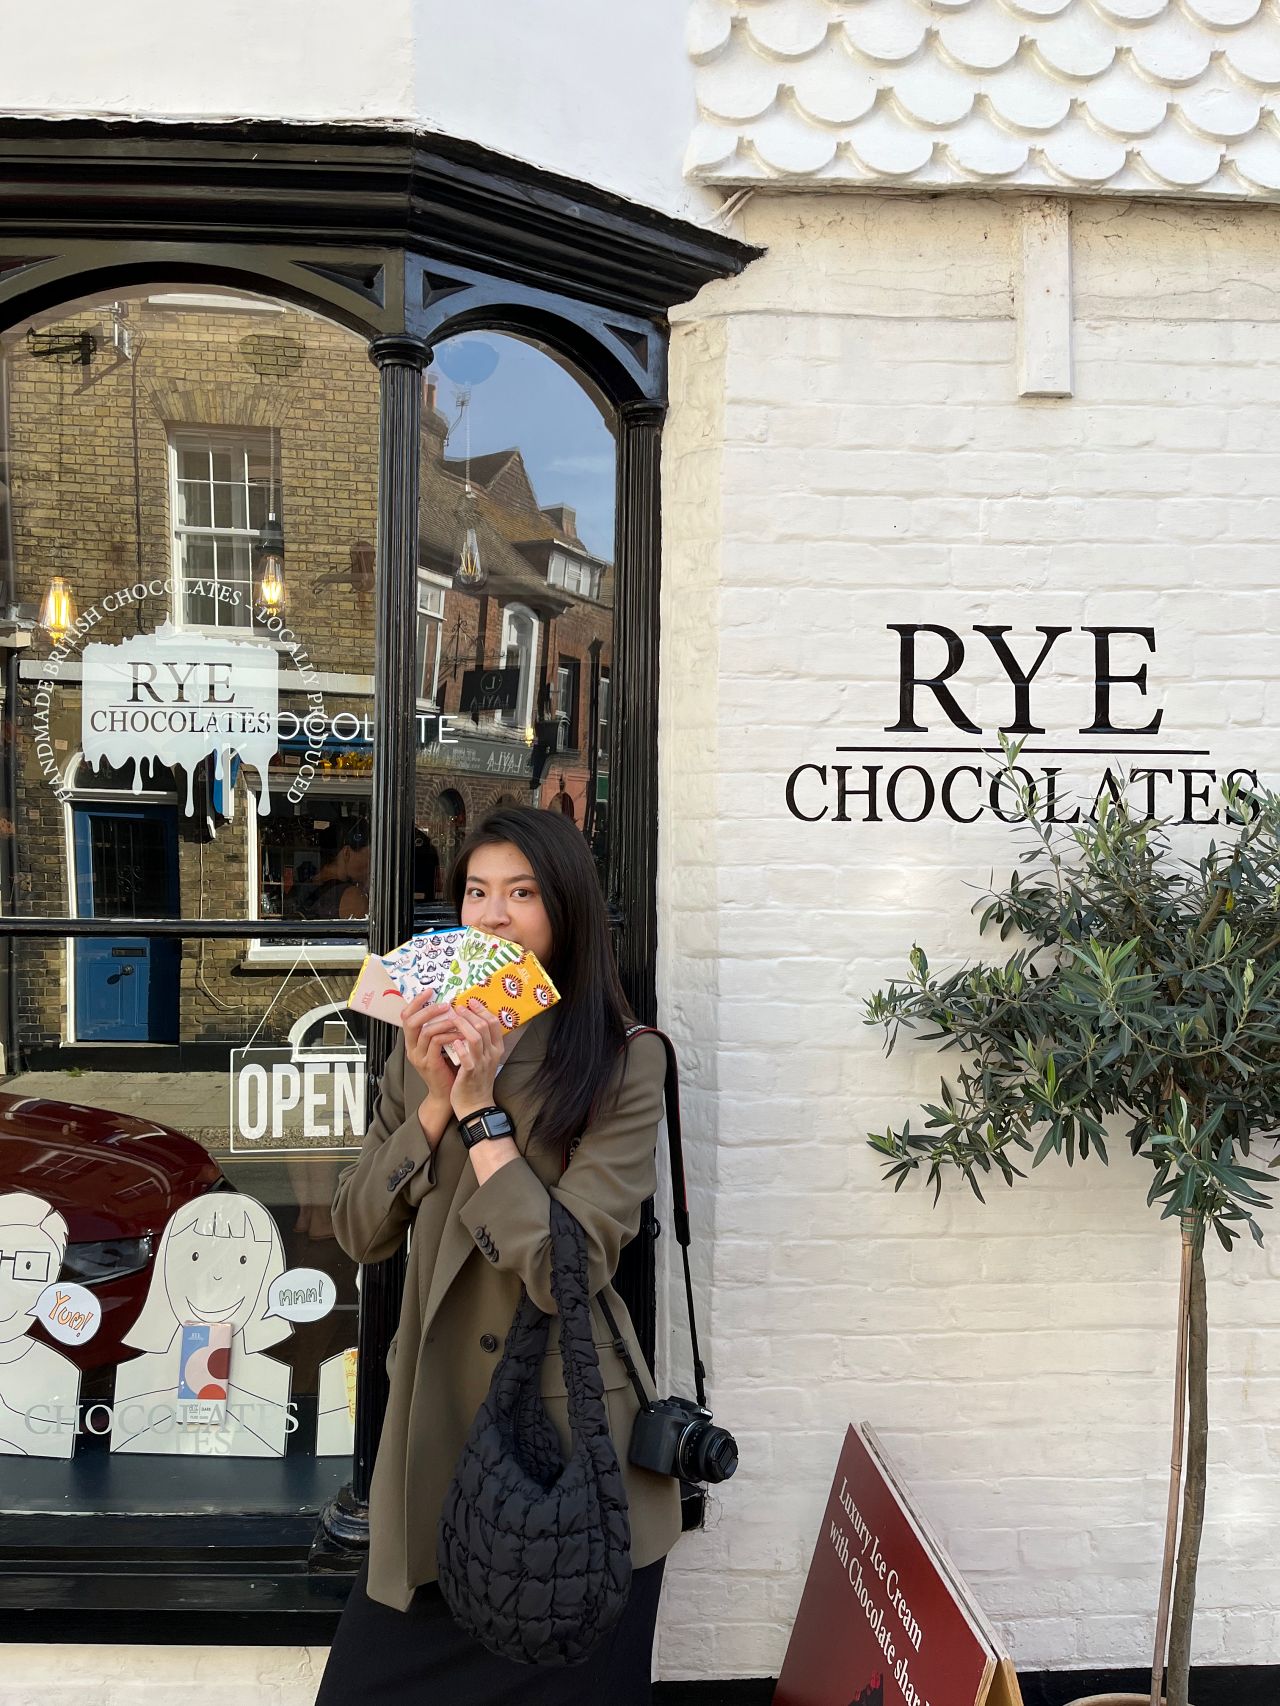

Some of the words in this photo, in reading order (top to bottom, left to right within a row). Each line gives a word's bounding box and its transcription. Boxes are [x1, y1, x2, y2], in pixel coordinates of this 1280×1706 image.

[102, 578, 242, 612] CHOCOLATES
[43, 606, 103, 677] BRITISH
[256, 606, 320, 685] LOCALLY
[884, 623, 1164, 735] RYE
[126, 661, 236, 703] RYE
[33, 680, 74, 803] HANDMADE
[90, 710, 271, 733] CHOCOLATES
[287, 691, 325, 804] PRODUCED
[785, 763, 1261, 826] CHOCOLATES
[238, 1062, 366, 1140] OPEN
[839, 1476, 872, 1555] Luxury
[870, 1535, 886, 1580] Ice
[886, 1569, 922, 1653] Cream
[830, 1519, 849, 1568] with
[849, 1557, 896, 1665] Chocolate
[894, 1657, 930, 1706] shar
